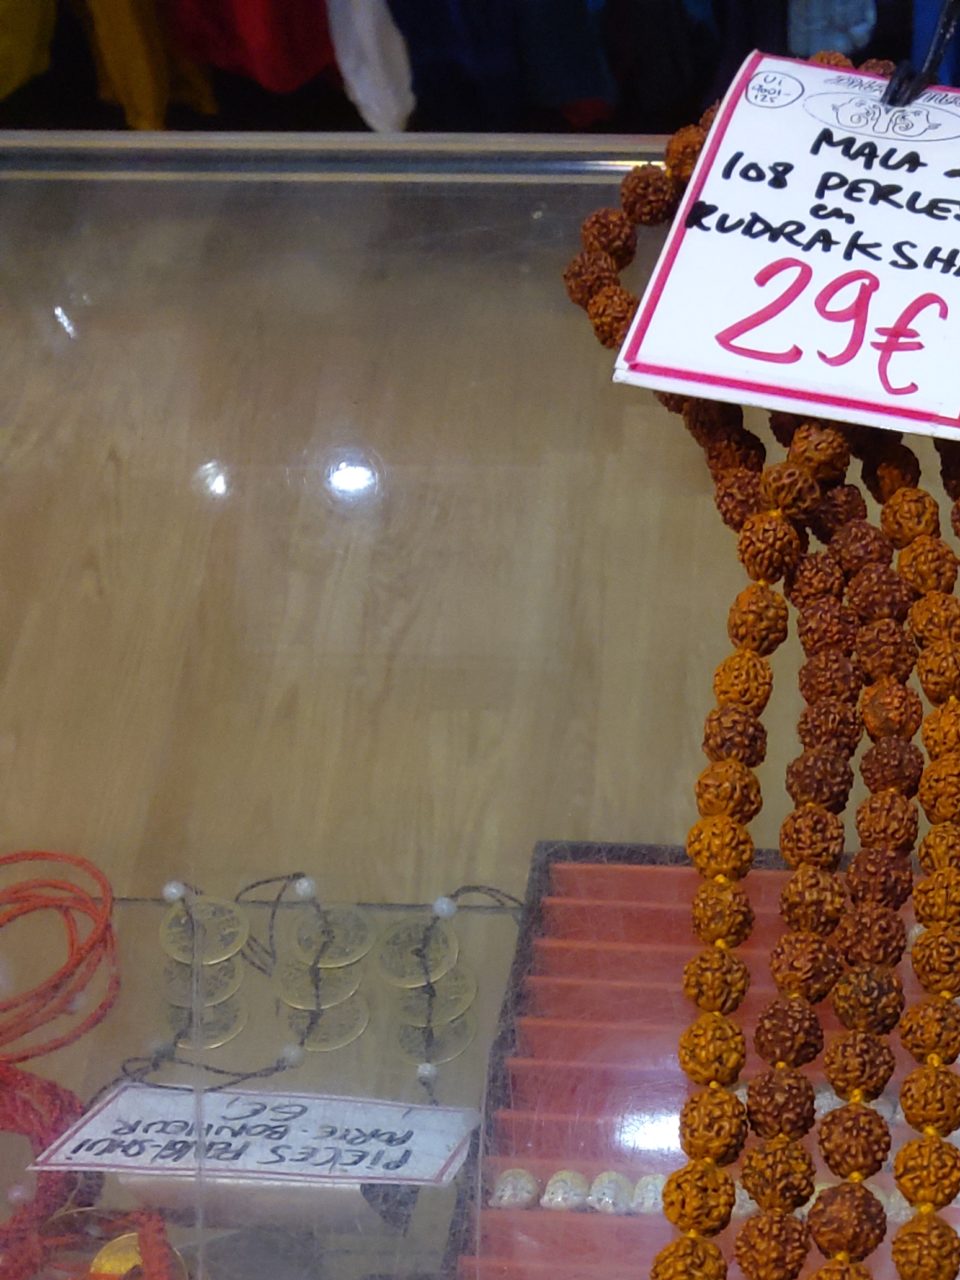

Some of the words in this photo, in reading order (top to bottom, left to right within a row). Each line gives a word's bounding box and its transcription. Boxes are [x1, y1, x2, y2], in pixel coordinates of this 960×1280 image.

[722, 151, 794, 189] 108
[810, 128, 927, 173] MALA
[715, 257, 948, 395] 29€
